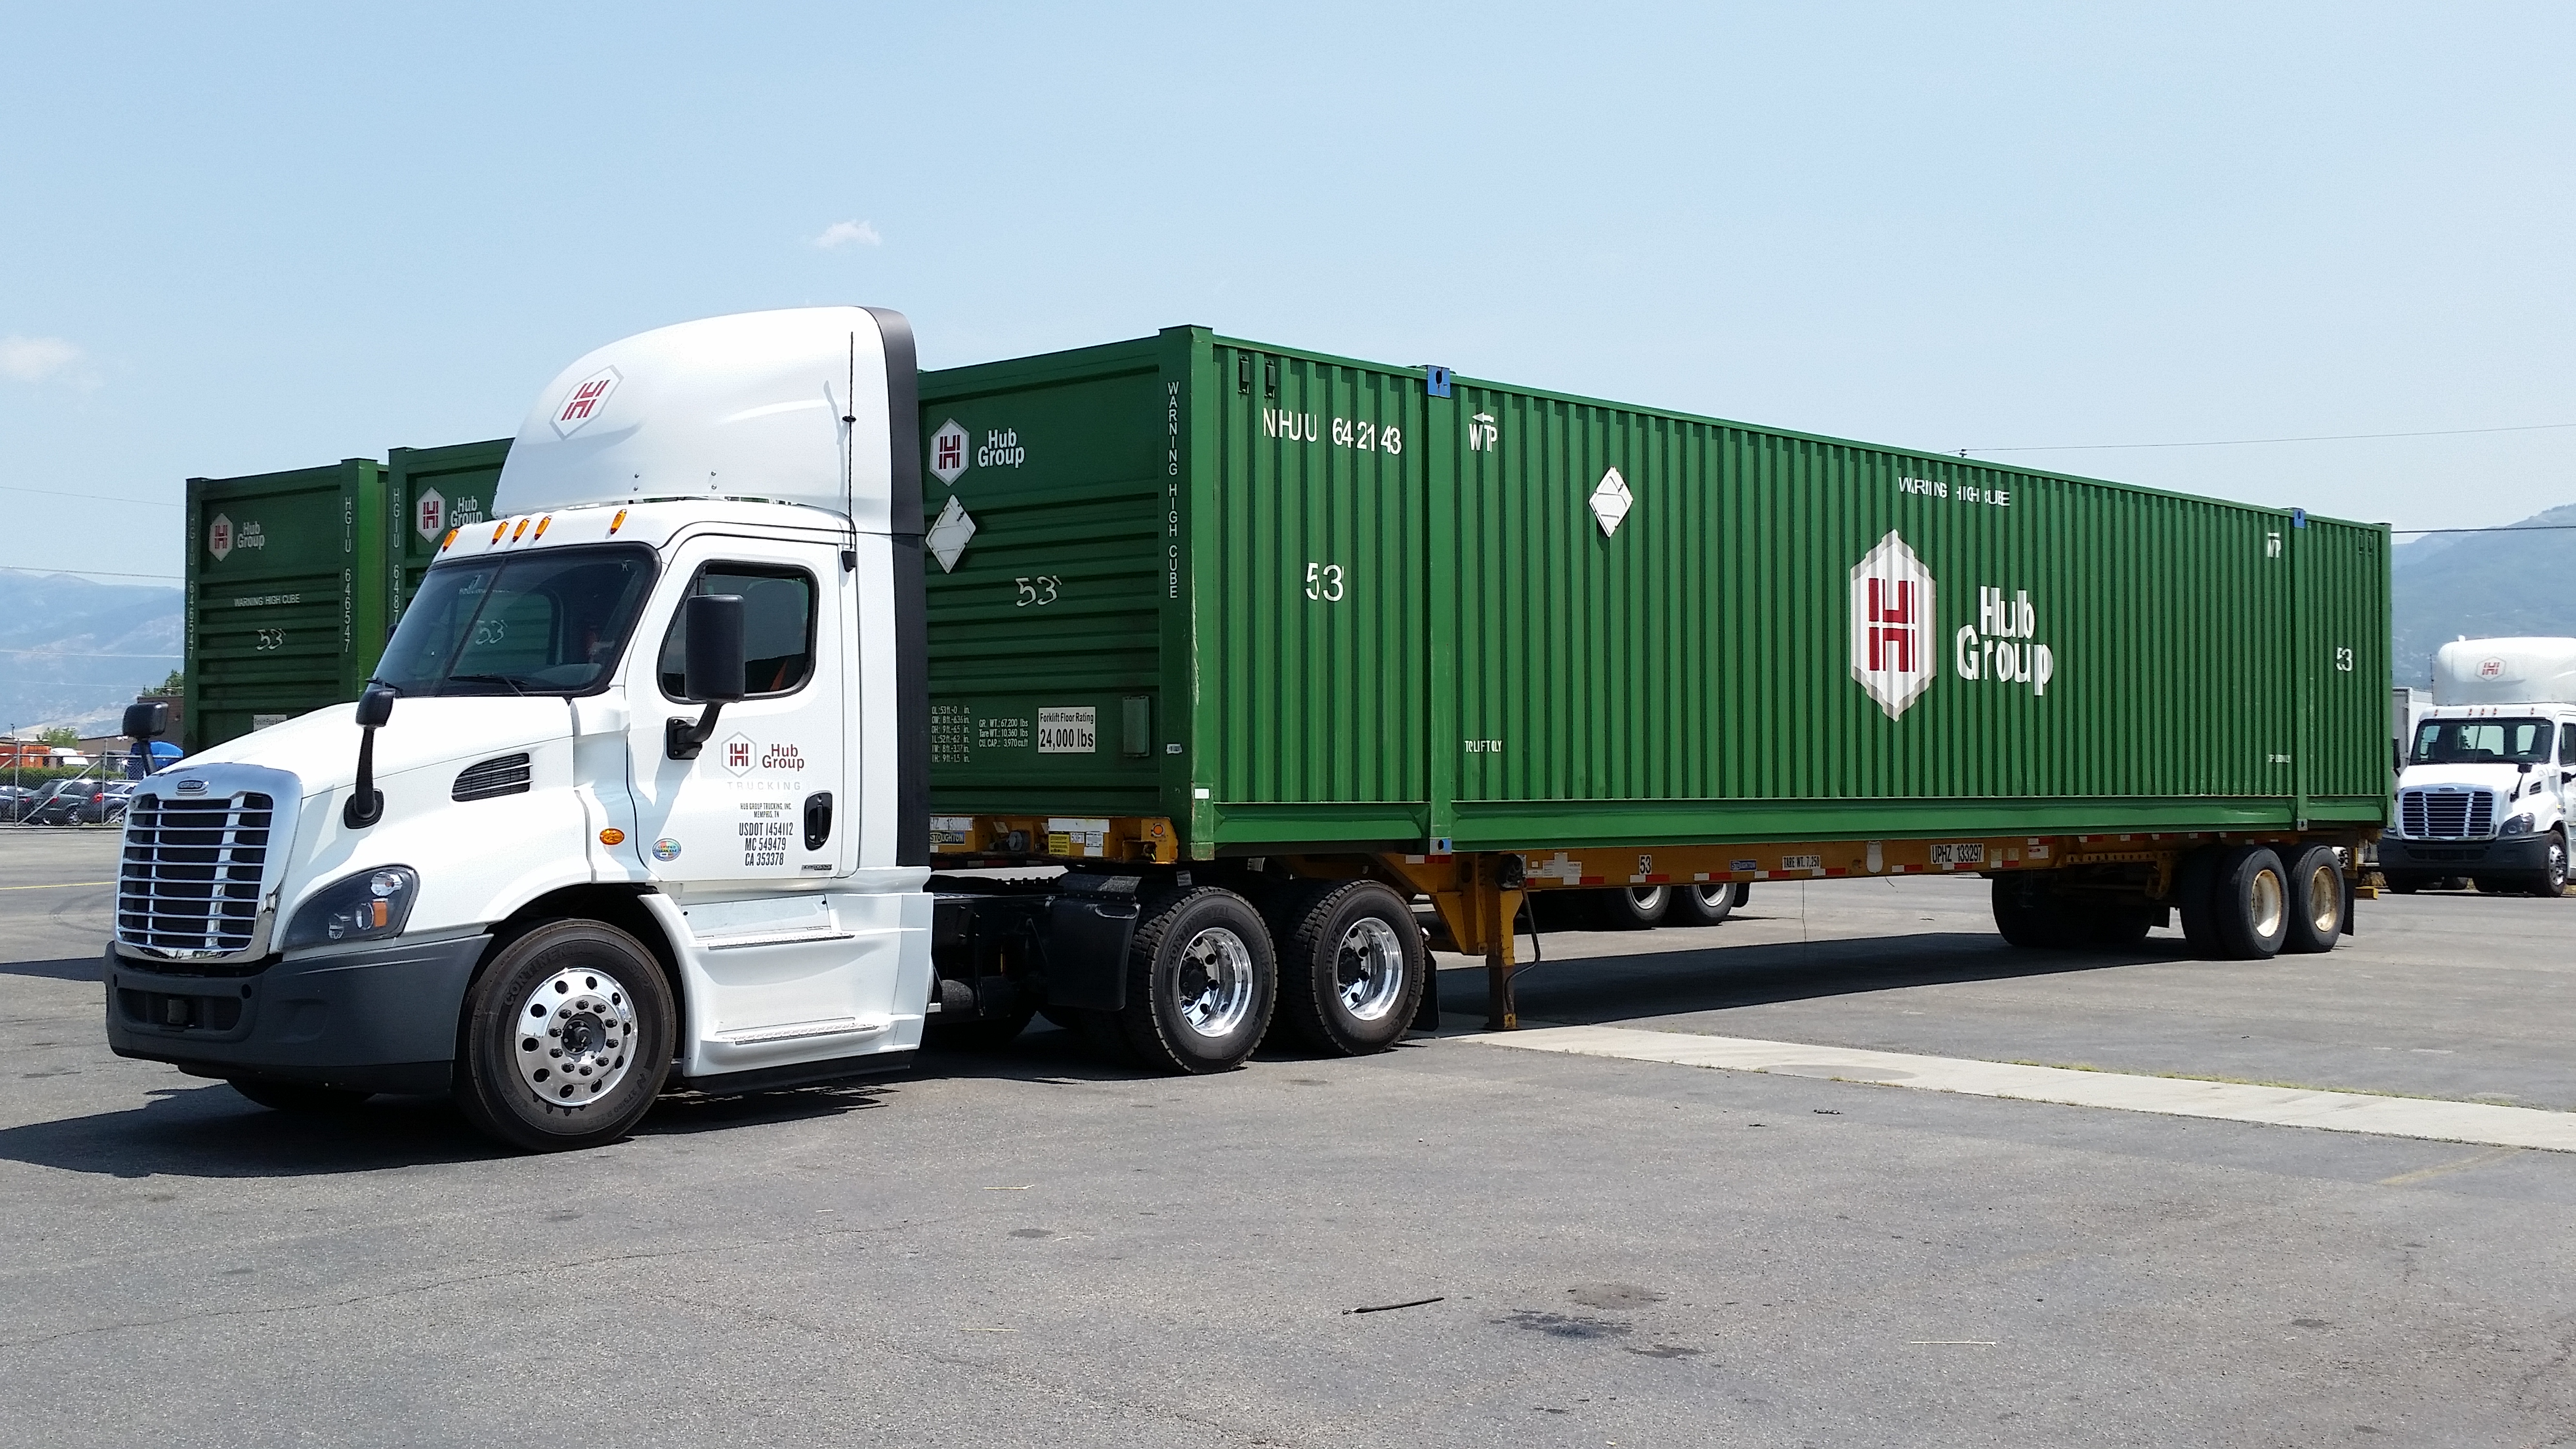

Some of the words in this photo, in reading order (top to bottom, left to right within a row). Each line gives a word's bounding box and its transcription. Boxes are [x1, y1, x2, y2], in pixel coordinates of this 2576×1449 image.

[1168, 382, 1179, 475] WARNING
[988, 428, 1016, 449] Hub
[1469, 423, 1497, 453] WTP
[977, 446, 1025, 468] Group
[1898, 477, 1947, 498] WRING
[457, 496, 477, 513] Hub
[1169, 484, 1177, 537] HIGH
[451, 510, 483, 527] Group
[243, 521, 260, 535] Hub
[237, 533, 265, 550] Group
[1169, 545, 1177, 599] CUBE
[235, 596, 263, 607] WARNING
[265, 596, 281, 604] HIGH
[282, 594, 300, 604] CUBE
[1980, 585, 2034, 639] Hub
[1957, 624, 2053, 696] Group
[1020, 718, 1028, 727] lbs
[1040, 712, 1060, 722] Forklift
[1061, 713, 1075, 722] Floor
[1076, 712, 1094, 724] Rating
[979, 729, 989, 737] Tare
[1001, 728, 1017, 738] 10,360
[1020, 728, 1028, 737] lbs
[1040, 728, 1074, 750] 24,000
[1078, 728, 1093, 747] lbs
[771, 744, 798, 757] Hub
[1004, 739, 1017, 747] 3,970
[1491, 740, 1502, 752] OLY
[762, 755, 805, 771] Group
[727, 782, 800, 790] TRUCKING
[739, 822, 763, 836] USDOT
[766, 822, 793, 836] 1454112
[745, 837, 757, 851] MC
[759, 837, 786, 851] 549479
[930, 834, 964, 842] STOUGHTON
[745, 853, 754, 866] CA
[757, 852, 784, 866] 353378
[1932, 845, 1952, 863] UPHZ
[1957, 844, 1982, 862] 133297
[1640, 856, 1651, 874] 53
[1784, 857, 1795, 868] TARE
